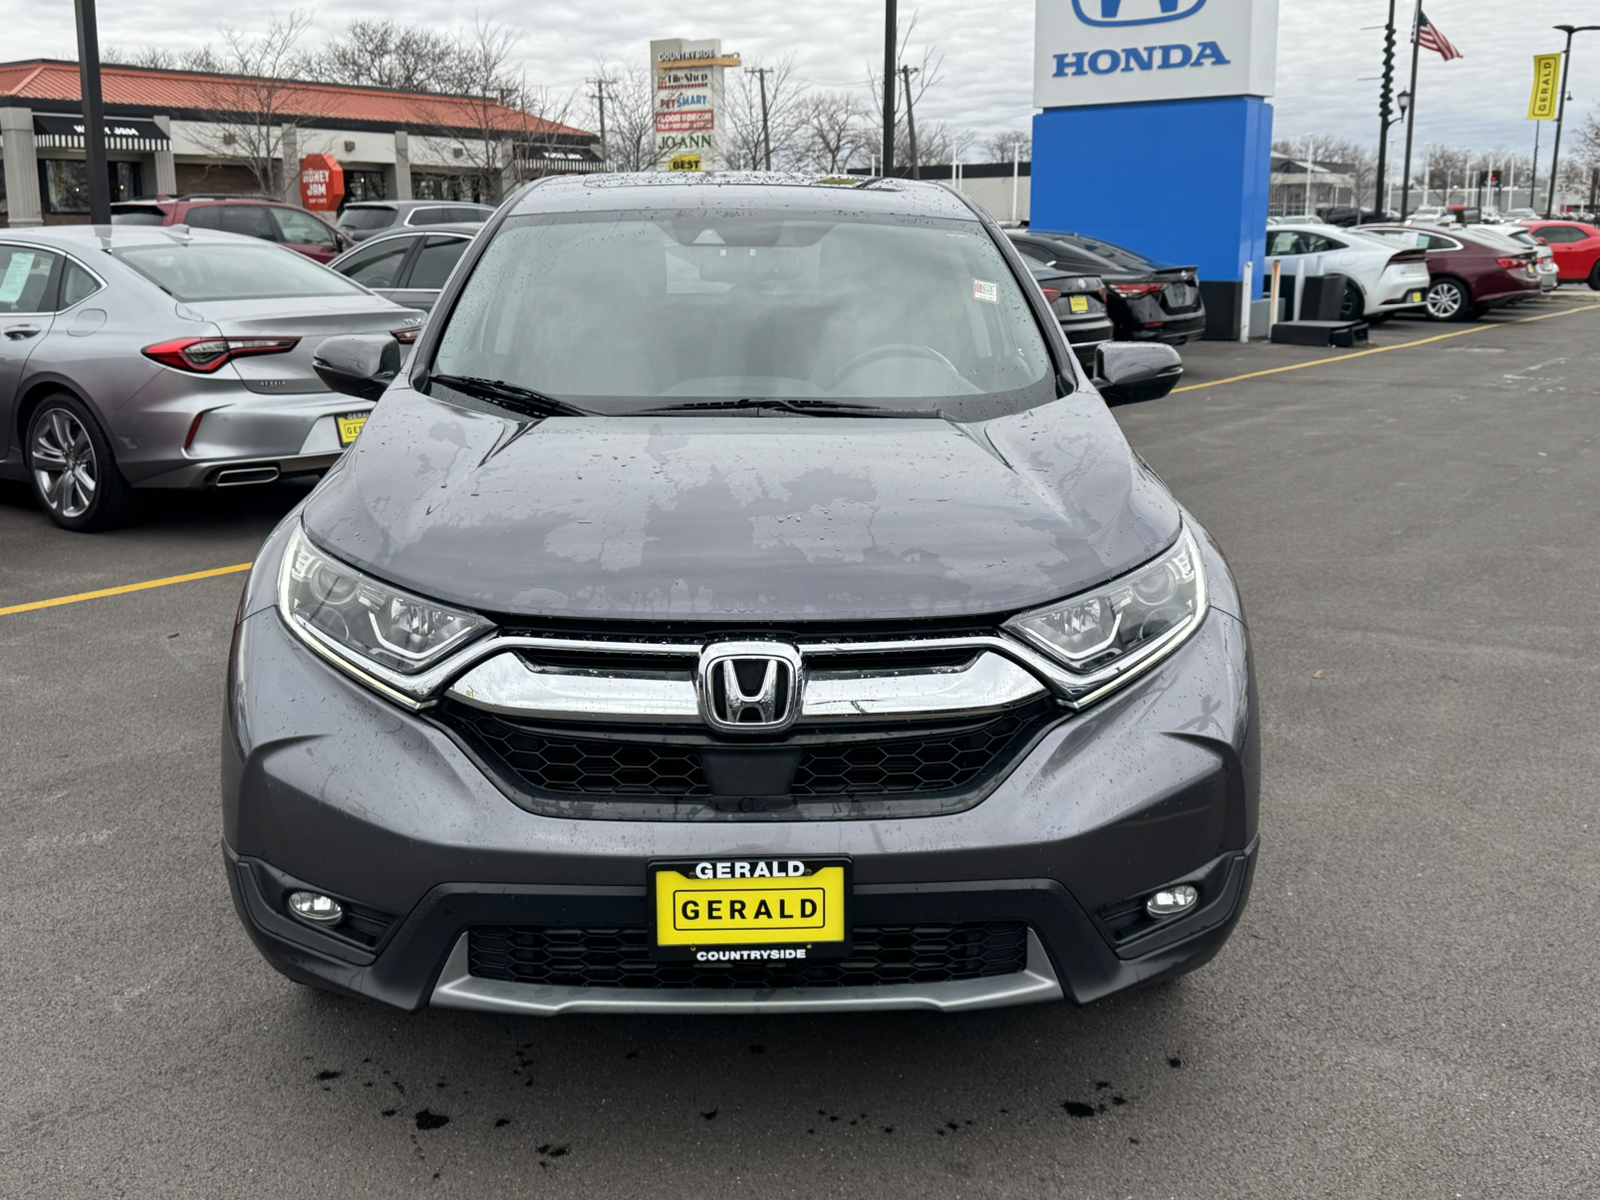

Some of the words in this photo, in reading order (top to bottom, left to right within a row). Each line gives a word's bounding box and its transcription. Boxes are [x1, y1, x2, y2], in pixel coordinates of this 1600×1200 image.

[1052, 41, 1231, 78] HONDA
[684, 73, 708, 83] Shop
[1538, 61, 1552, 112] GERALD
[673, 161, 700, 170] BEST
[302, 169, 330, 184] HONEY
[307, 183, 327, 196] JAM
[347, 411, 371, 420] GERAL
[695, 860, 806, 880] GERALD
[681, 898, 818, 921] GERALD
[696, 949, 807, 962] COUNTRYSIDE
